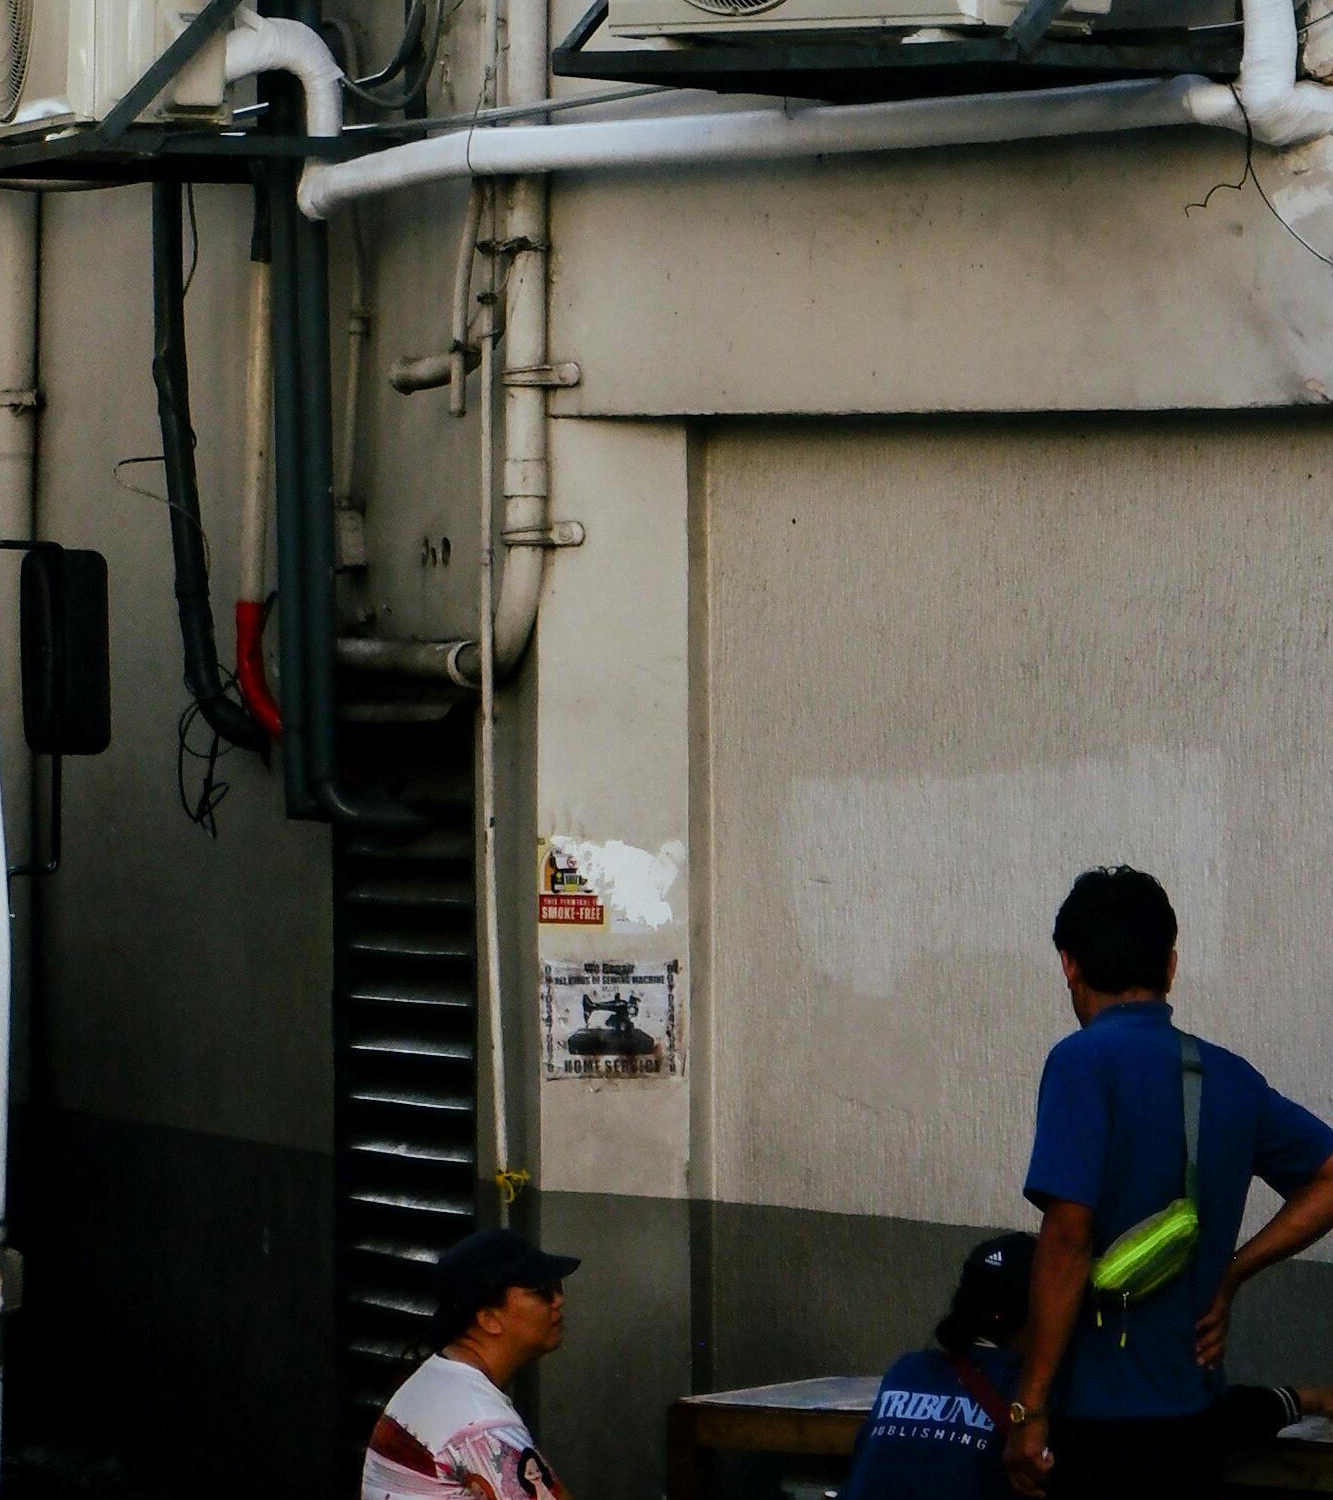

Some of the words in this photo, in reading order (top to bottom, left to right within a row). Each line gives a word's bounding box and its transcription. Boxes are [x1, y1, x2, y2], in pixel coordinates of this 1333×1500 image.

[541, 905, 602, 921] SMOKE-FREE
[564, 1059, 600, 1074] HOME
[877, 1389, 996, 1433] TRIBUNE
